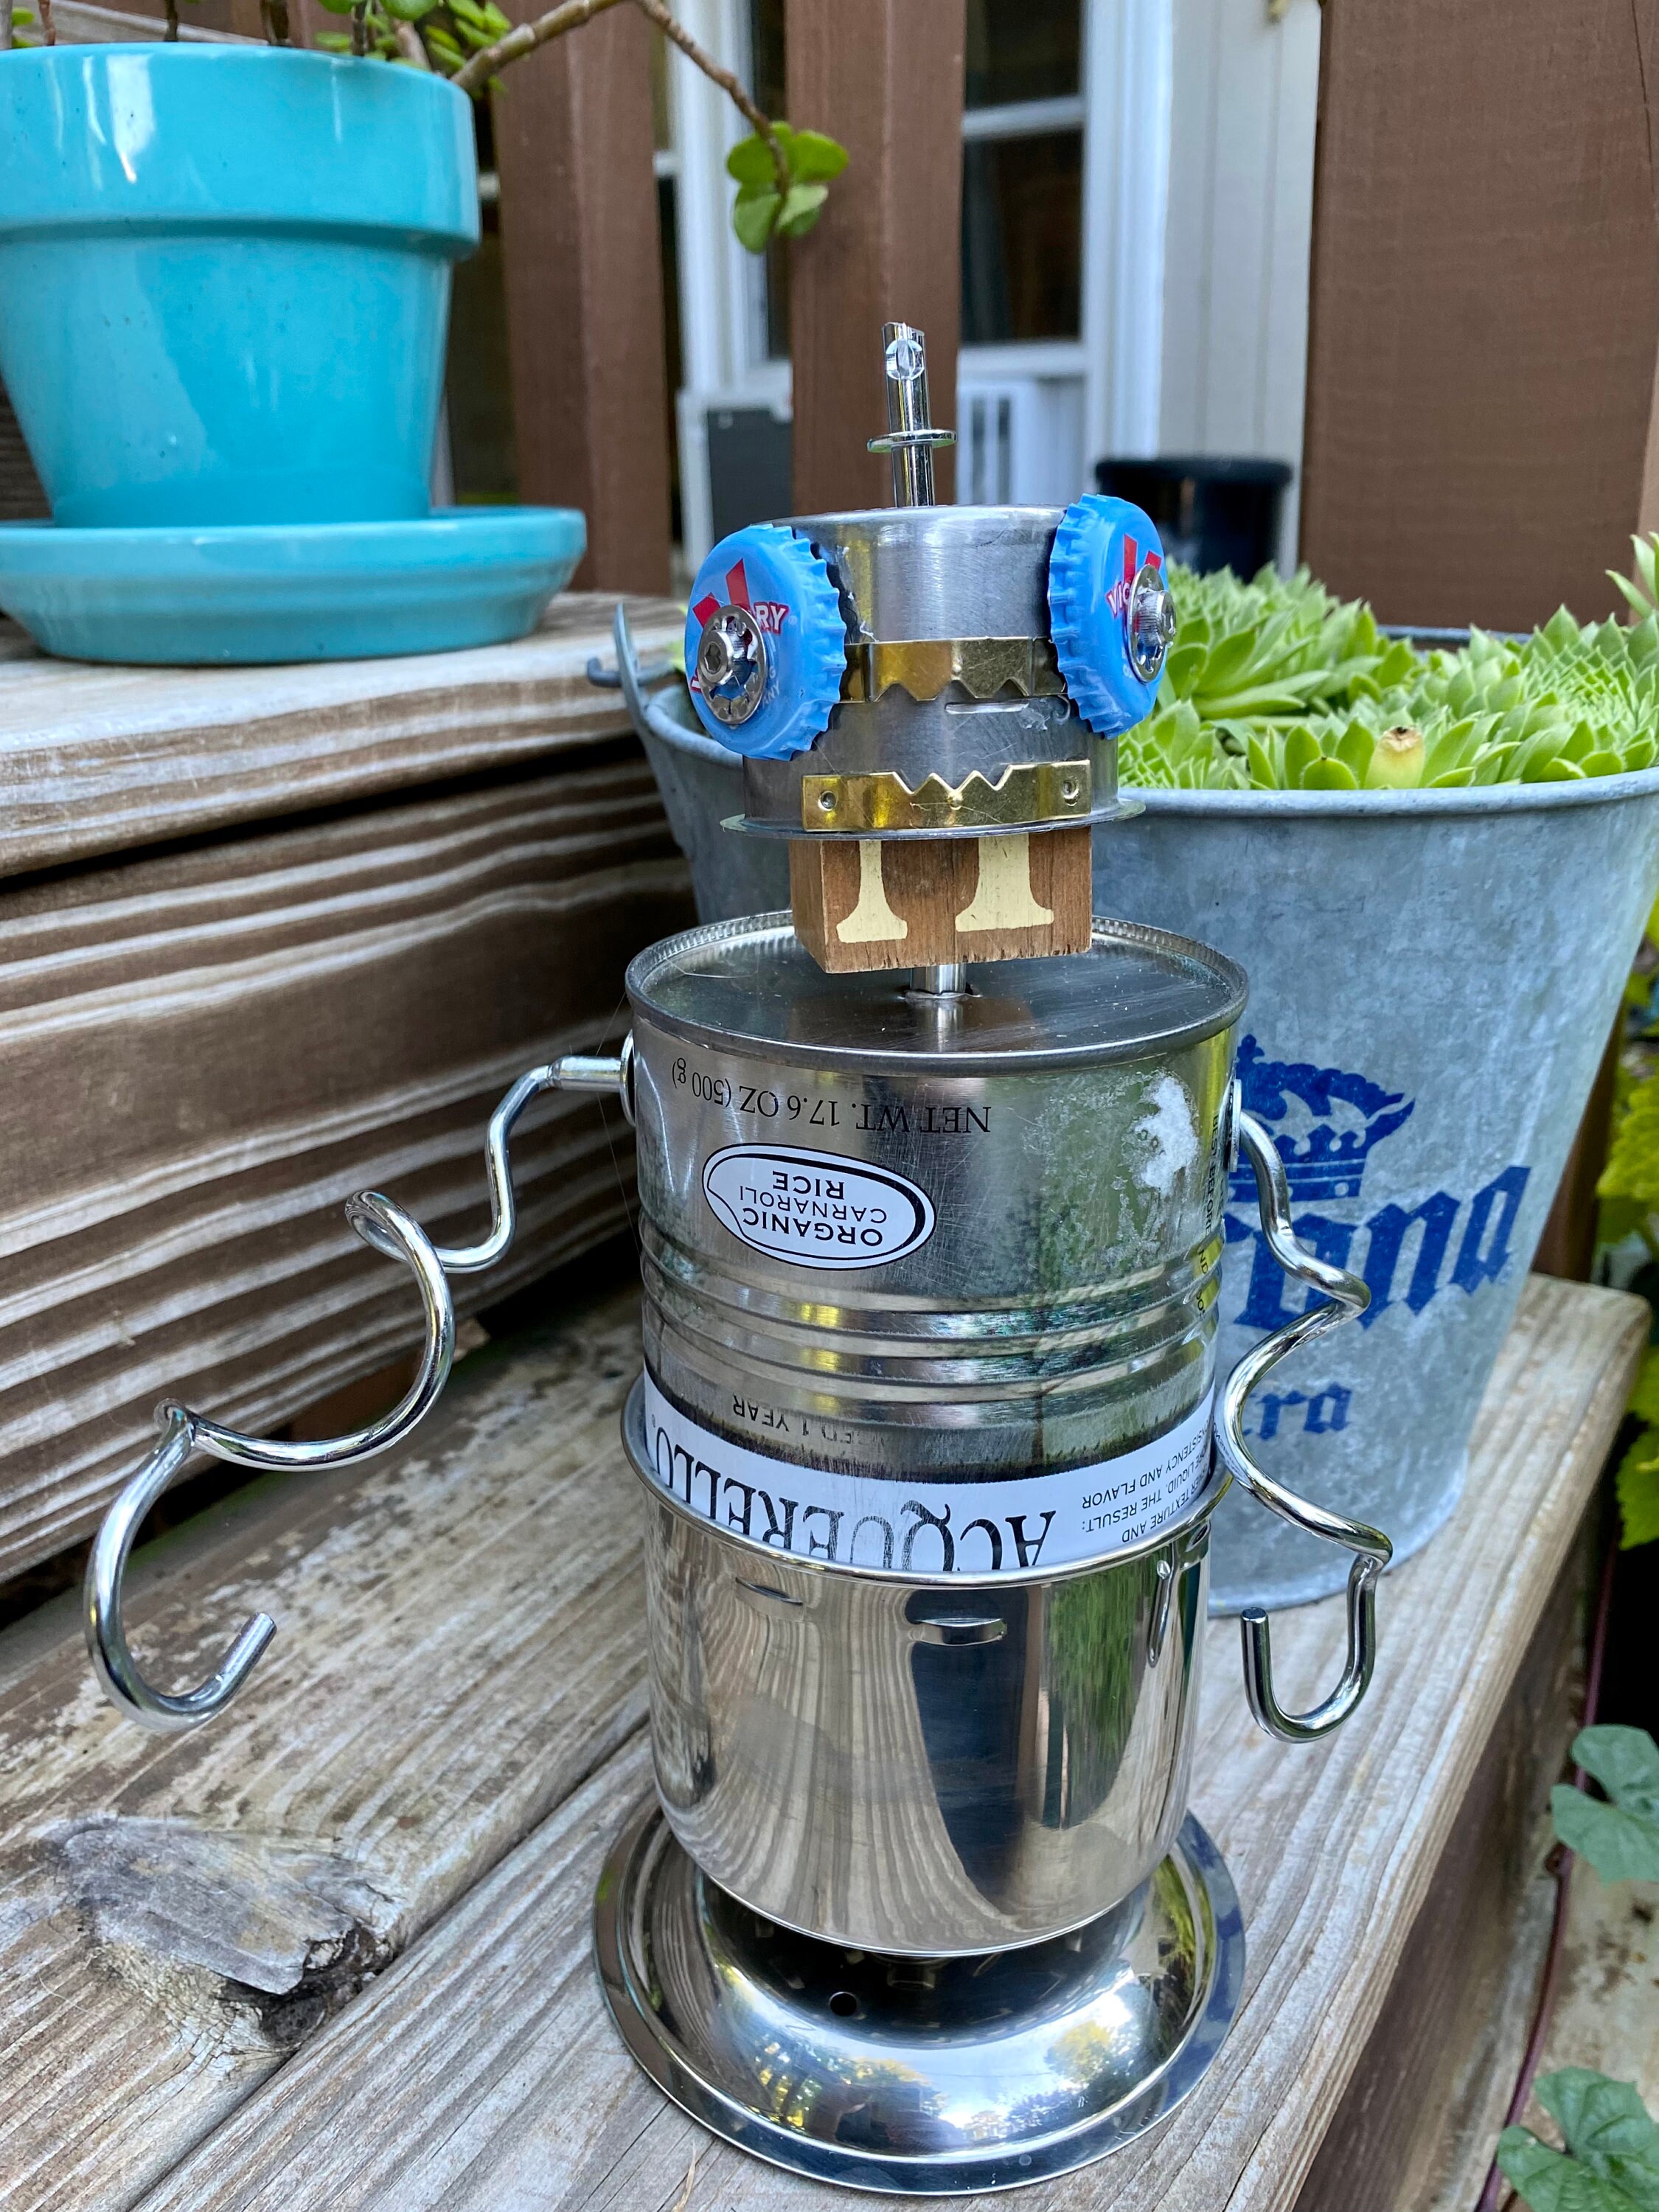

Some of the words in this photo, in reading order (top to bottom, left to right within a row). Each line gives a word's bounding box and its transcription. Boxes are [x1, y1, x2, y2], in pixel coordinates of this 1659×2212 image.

[671, 1057, 686, 1088] g)
[692, 1072, 732, 1108] (500
[739, 1085, 779, 1118] OZ
[787, 1094, 841, 1127] 17.6
[852, 1103, 910, 1133] WT.
[920, 1106, 992, 1133] NET
[772, 1170, 845, 1200] RICE
[739, 1186, 887, 1224] CARNAROLI
[742, 1207, 883, 1247] ORGANIC
[731, 1394, 790, 1433] YEAR
[1139, 1464, 1163, 1488] AND
[1165, 1459, 1194, 1494] LIQUID.
[655, 1426, 1056, 1572] ACQUERELLO
[1082, 1478, 1136, 1509] FLAVOR
[1141, 1489, 1162, 1512] THE
[1150, 1489, 1189, 1529] TEXTURE
[1081, 1502, 1137, 1533] RESULT:
[1121, 1520, 1147, 1543] AND
